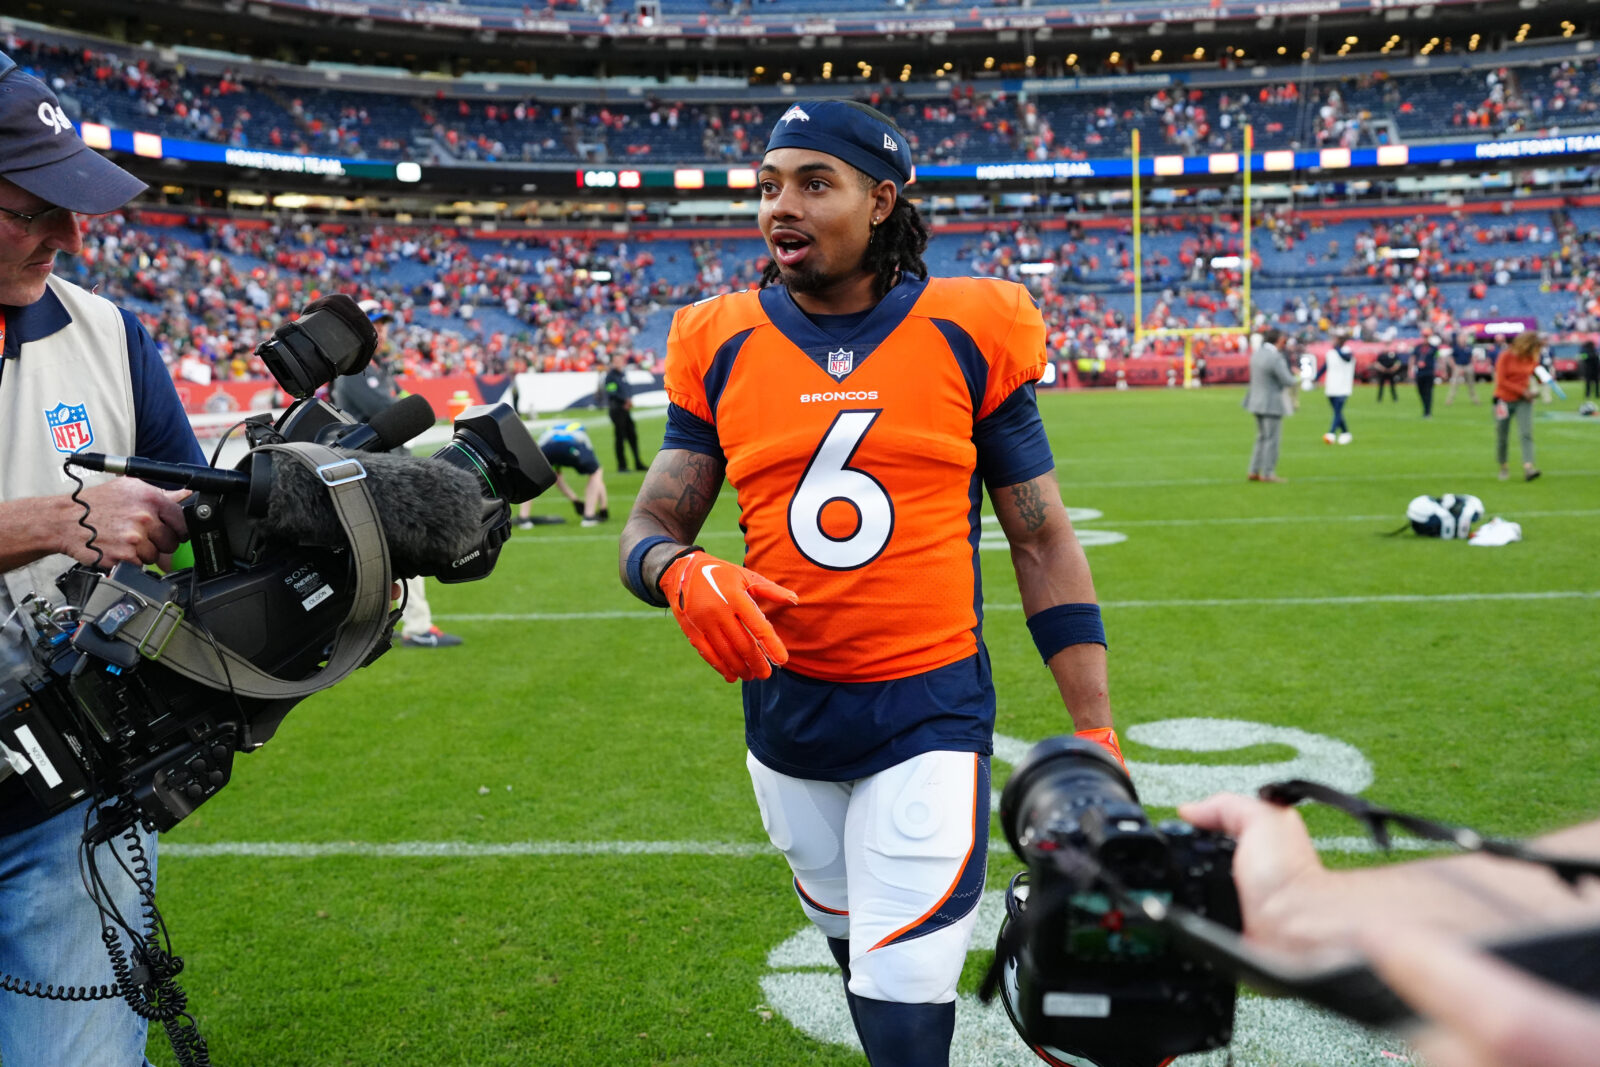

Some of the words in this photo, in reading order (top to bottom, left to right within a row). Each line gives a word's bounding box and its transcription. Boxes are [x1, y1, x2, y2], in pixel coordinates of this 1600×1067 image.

[1476, 138, 1565, 158] HOMETOWN
[225, 149, 304, 172] HOMETOWN
[976, 164, 1054, 180] HOMETOWN
[831, 360, 849, 373] NFL
[800, 391, 879, 403] BRONCOS
[53, 422, 90, 449] NFL
[787, 408, 895, 572] 6
[452, 550, 480, 568] Canon
